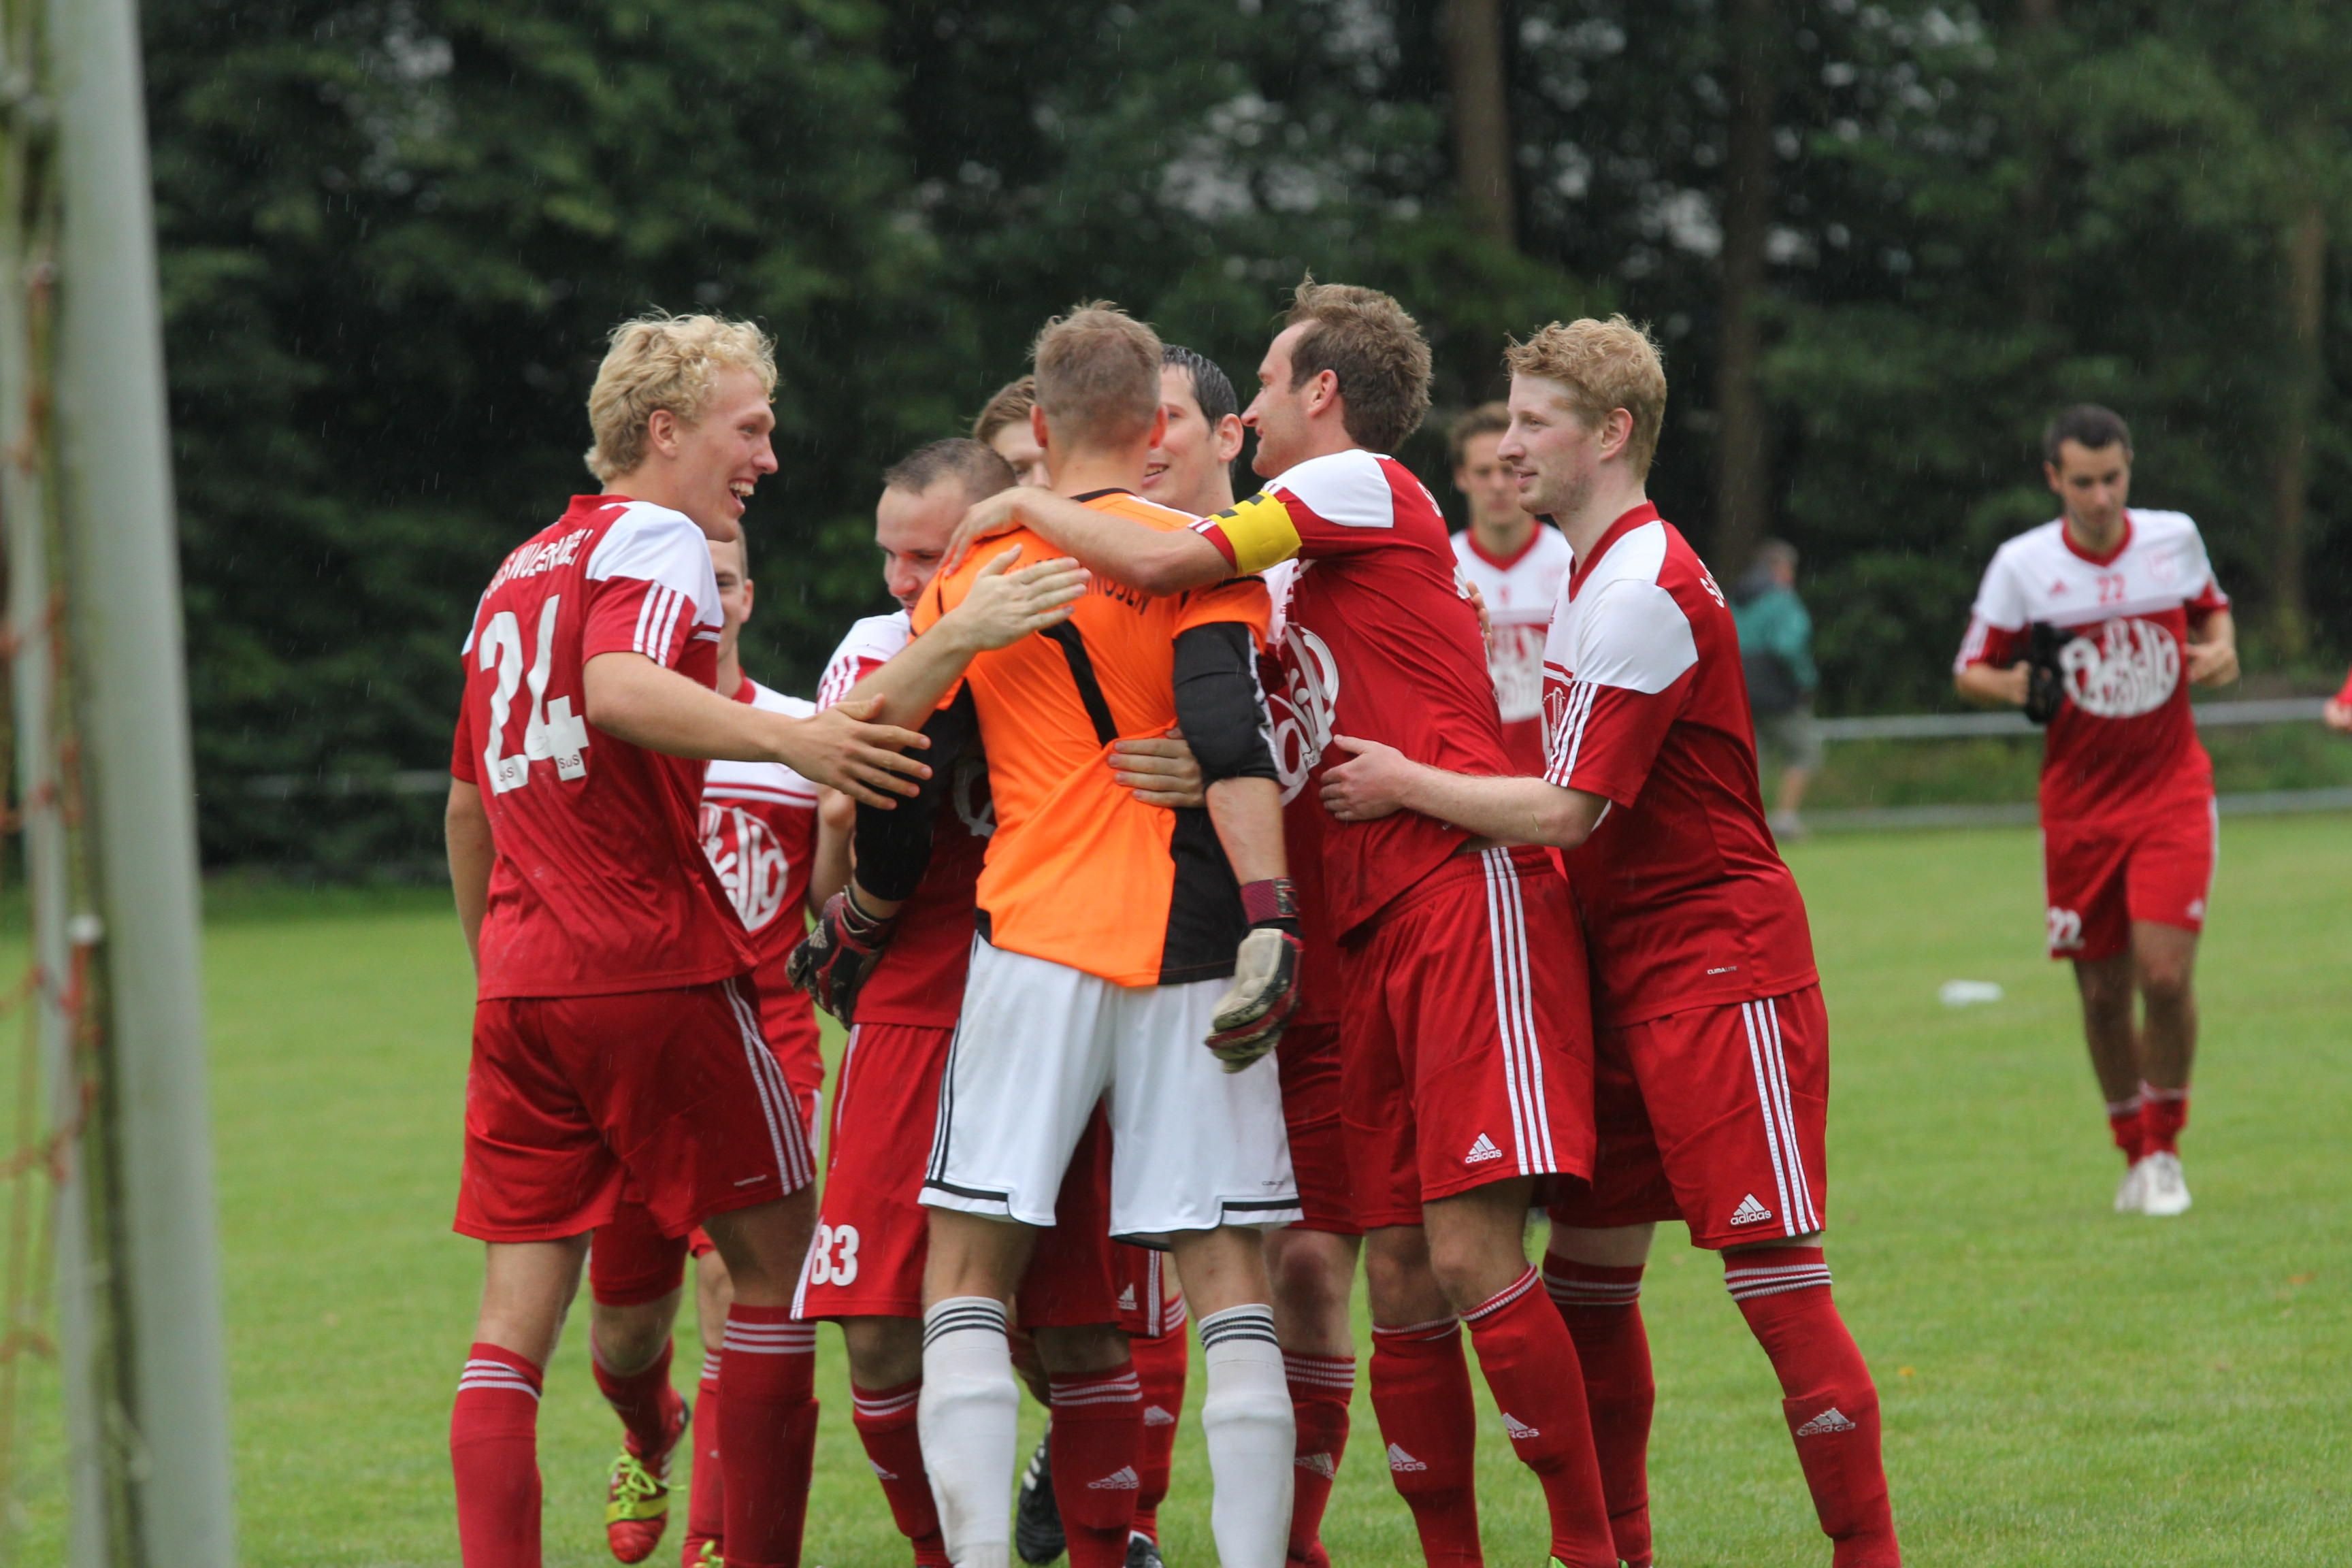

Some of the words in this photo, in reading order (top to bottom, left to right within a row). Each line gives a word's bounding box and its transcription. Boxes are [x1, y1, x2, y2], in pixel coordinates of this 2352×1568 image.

[478, 593, 590, 796] 24
[557, 753, 581, 770] SuS
[1465, 1149, 1503, 1164] adidas
[1730, 1209, 1772, 1226] adidas
[810, 1224, 860, 1287] 83
[1796, 1422, 1857, 1437] adidas
